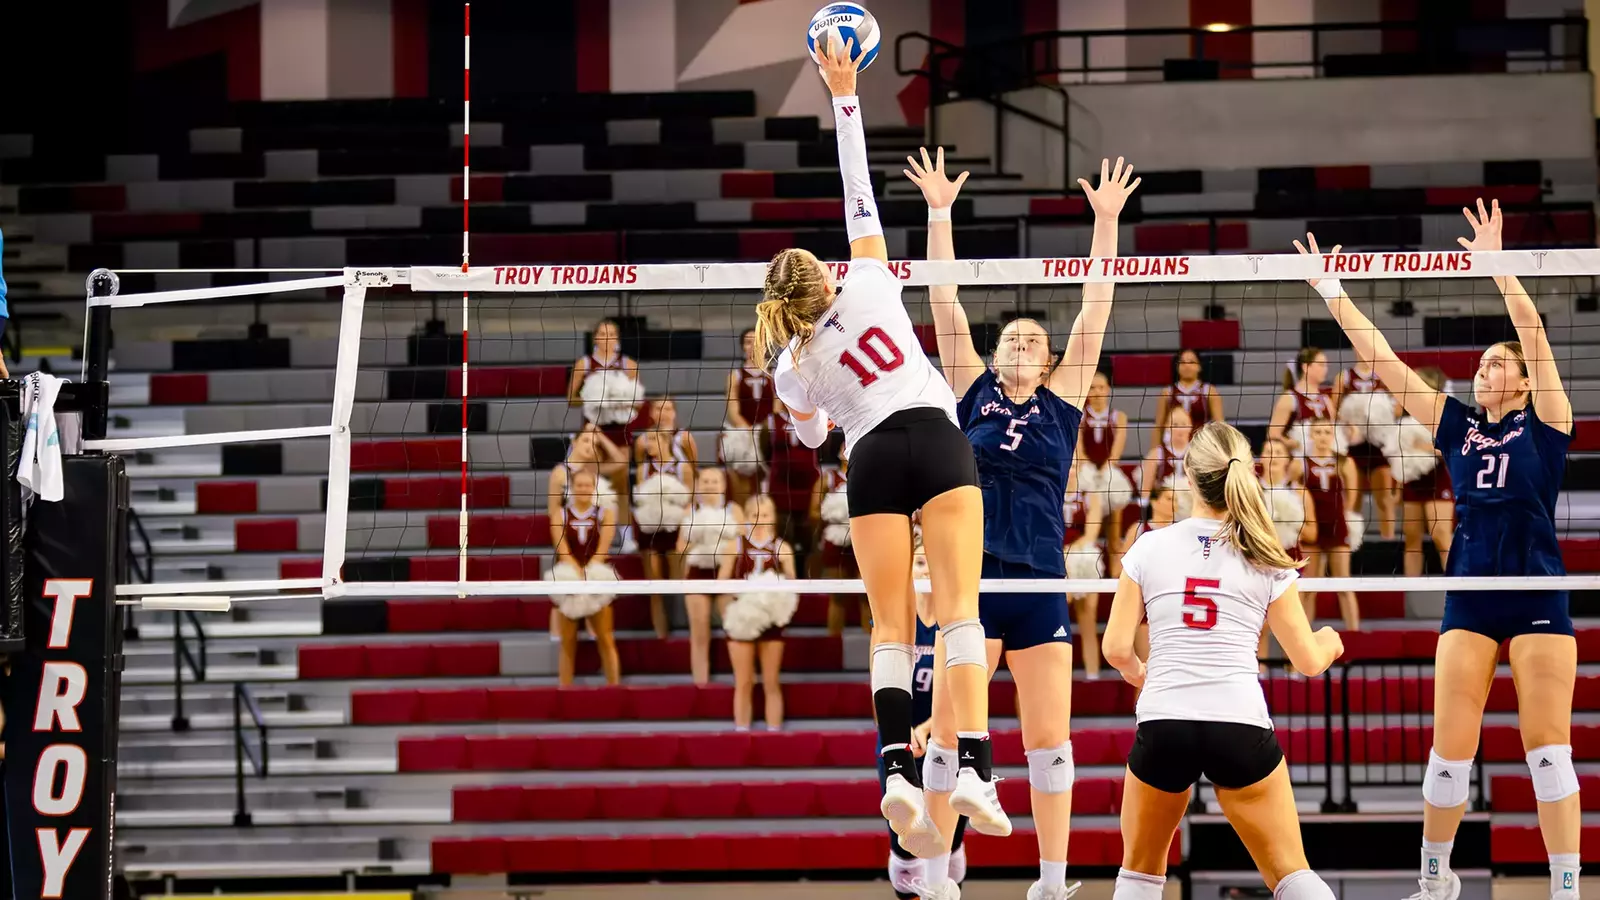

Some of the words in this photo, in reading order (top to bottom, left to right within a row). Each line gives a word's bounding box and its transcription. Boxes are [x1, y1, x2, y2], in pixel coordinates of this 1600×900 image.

[814, 15, 852, 31] molten
[493, 266, 544, 285] TROY
[550, 265, 637, 285] TROJANS
[827, 260, 912, 281] TRNS
[1042, 258, 1093, 277] TROY
[1101, 256, 1190, 276] TROJANS
[1321, 253, 1375, 273] TROY
[1382, 252, 1472, 272] TROJANS
[838, 326, 905, 389] 10
[999, 418, 1029, 452] 5
[1476, 453, 1510, 489] 21
[1181, 576, 1221, 630] 5
[915, 667, 934, 693] 9
[31, 578, 93, 899] TROY
